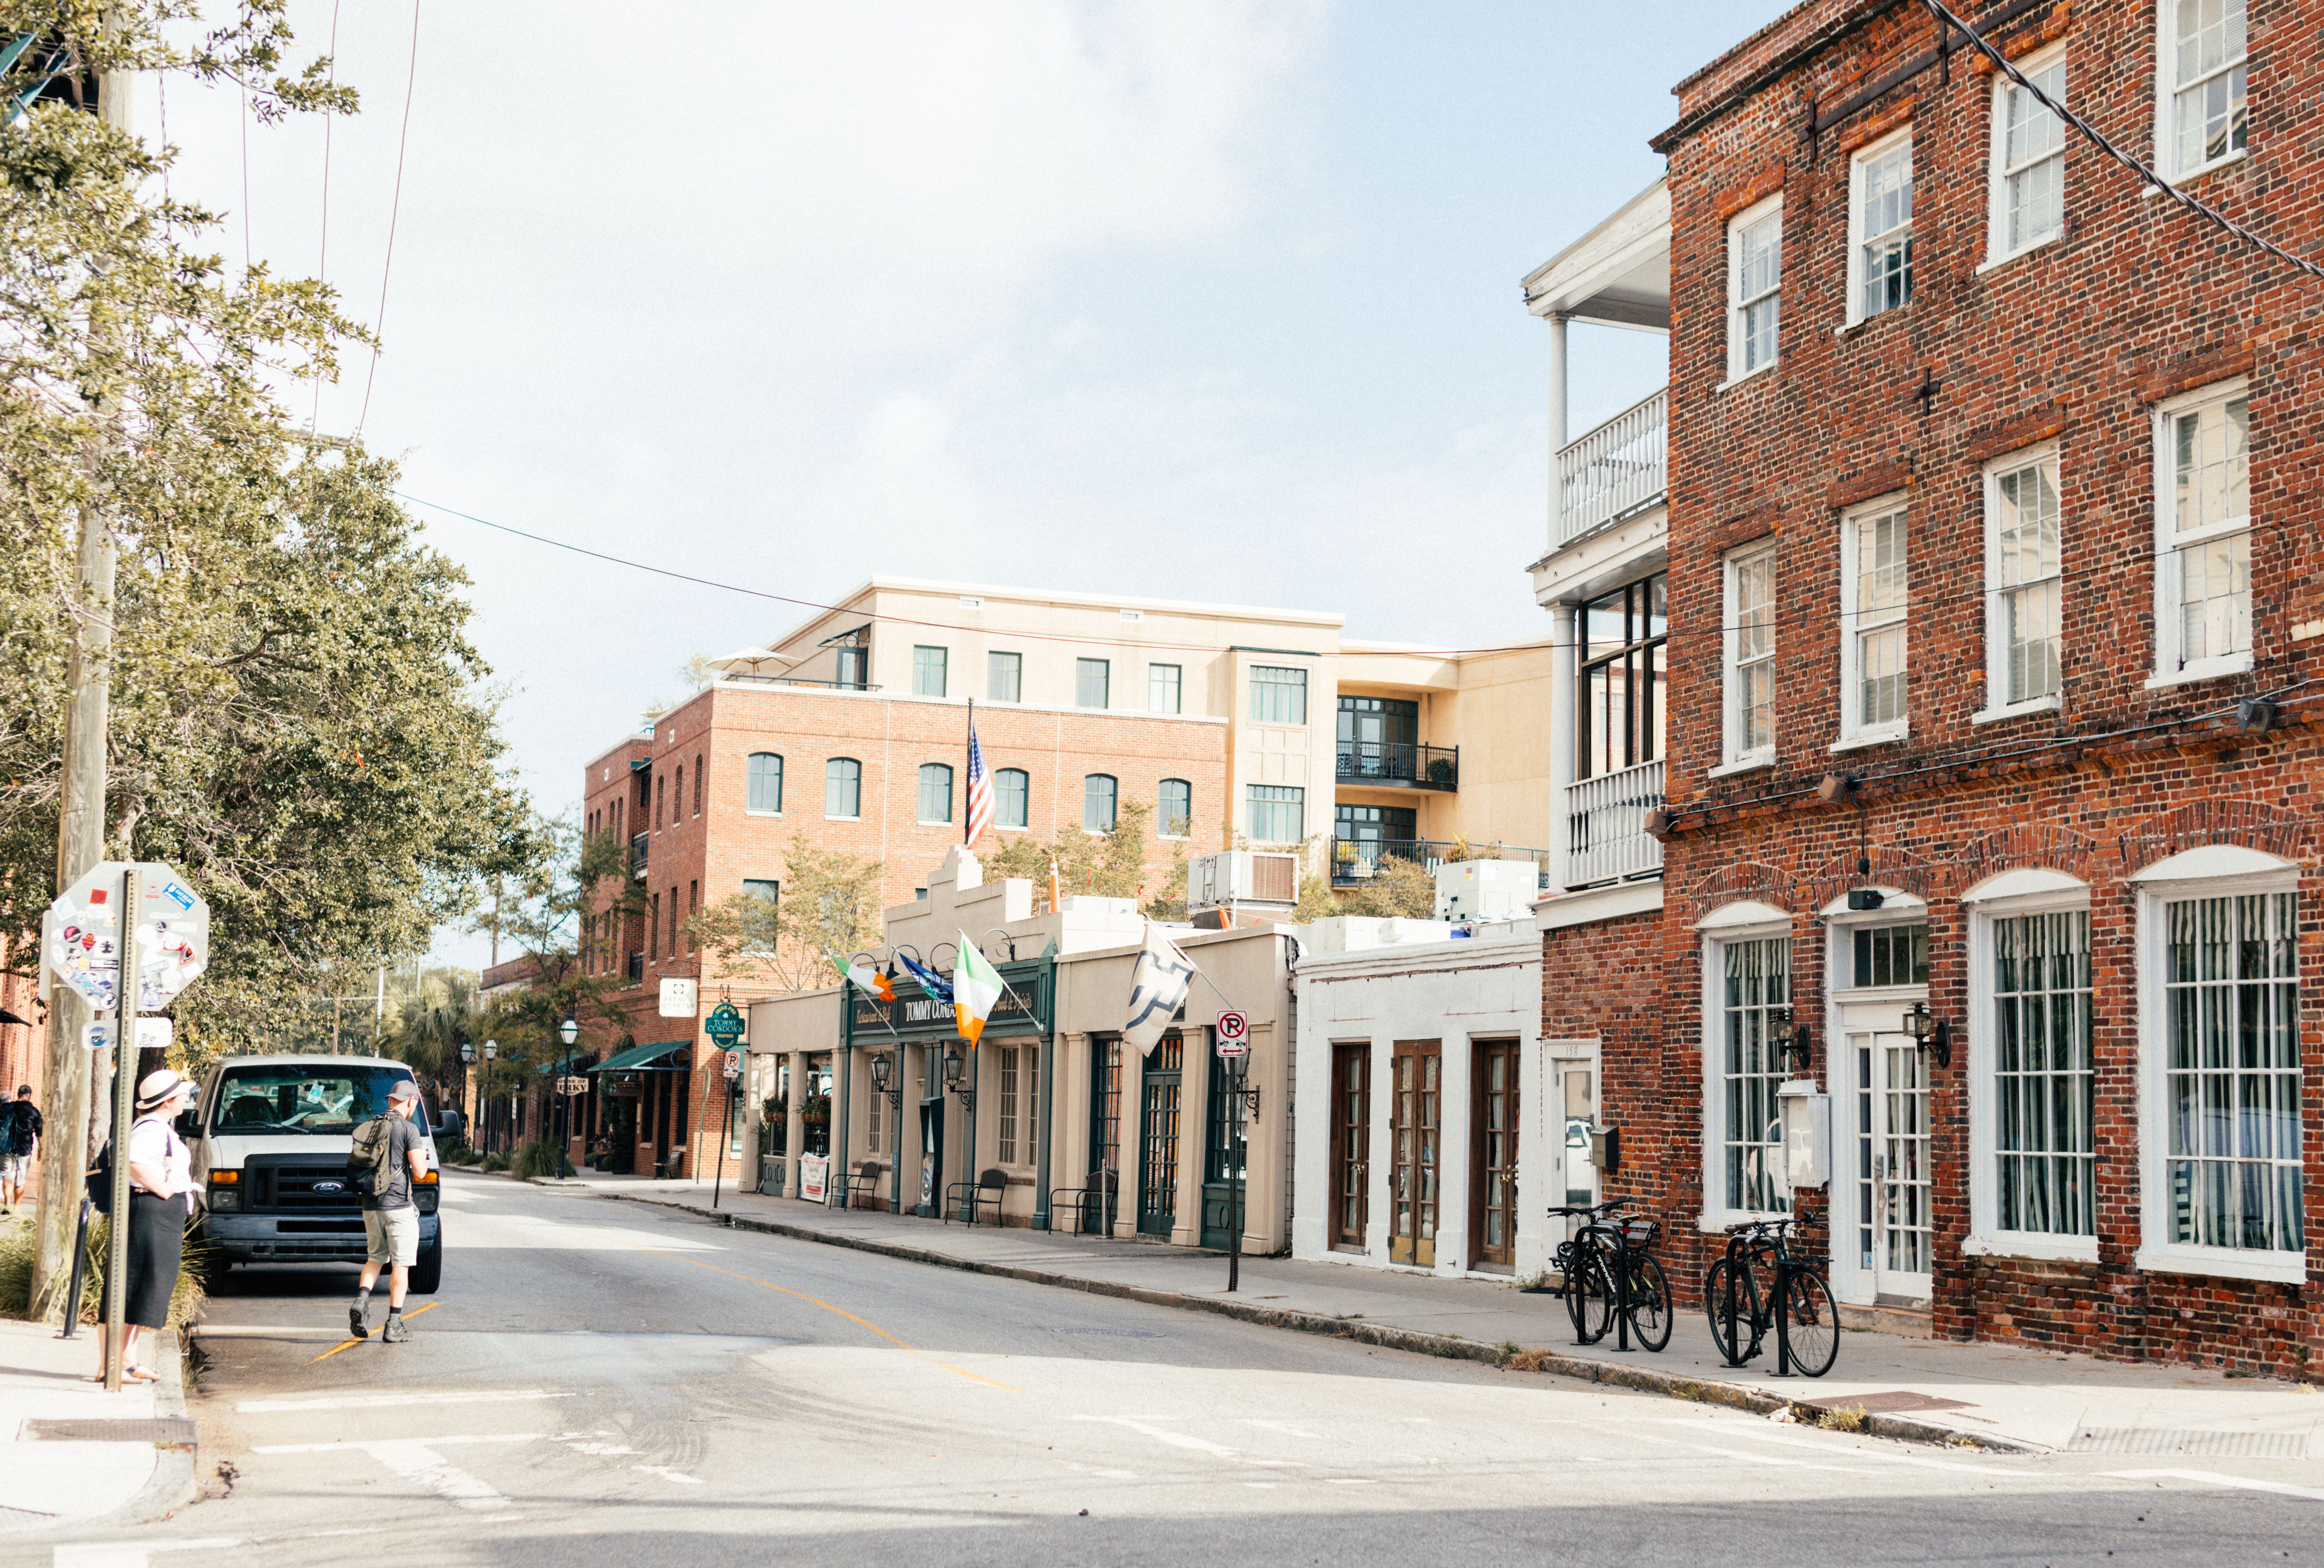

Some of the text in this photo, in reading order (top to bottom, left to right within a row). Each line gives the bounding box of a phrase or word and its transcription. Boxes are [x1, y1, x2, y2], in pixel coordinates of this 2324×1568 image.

[715, 1005, 737, 1015] IRISH PUB
[856, 1009, 878, 1024] Restaurant
[905, 999, 932, 1021] TOMMY
[715, 1039, 735, 1048] RESTAURANT
[1566, 1045, 1578, 1057] 158
[1592, 1246, 1616, 1293] cnnondale
